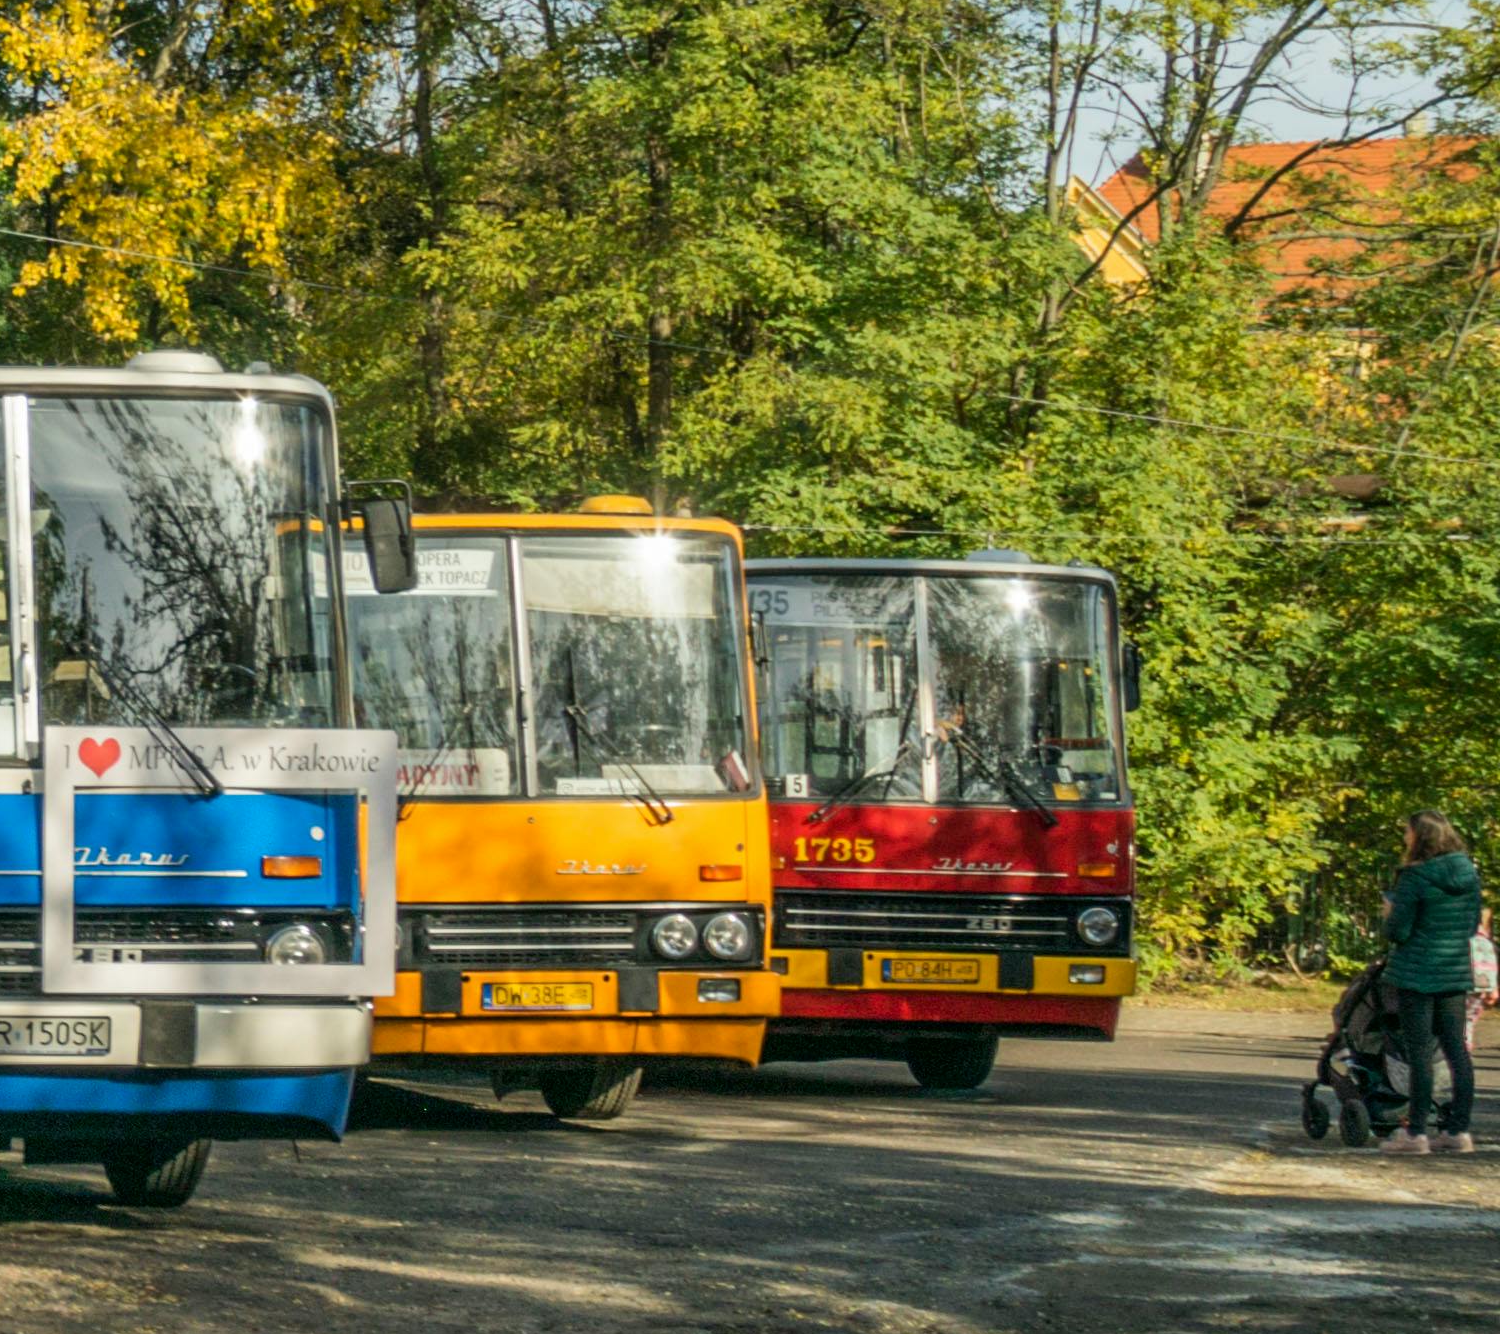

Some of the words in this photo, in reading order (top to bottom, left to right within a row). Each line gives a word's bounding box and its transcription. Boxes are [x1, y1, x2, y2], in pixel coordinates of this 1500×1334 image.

[416, 552, 461, 566] OPERA
[438, 570, 488, 585] TOPACZ
[749, 590, 790, 615] 135
[241, 753, 263, 770] w
[267, 742, 381, 773] Krakowie
[793, 776, 803, 793] 5
[74, 846, 190, 866] Ikarus
[794, 837, 876, 863] 1735
[931, 857, 1013, 871] Ikarus
[531, 985, 565, 1005] 38E
[24, 1020, 106, 1046] 150SK
